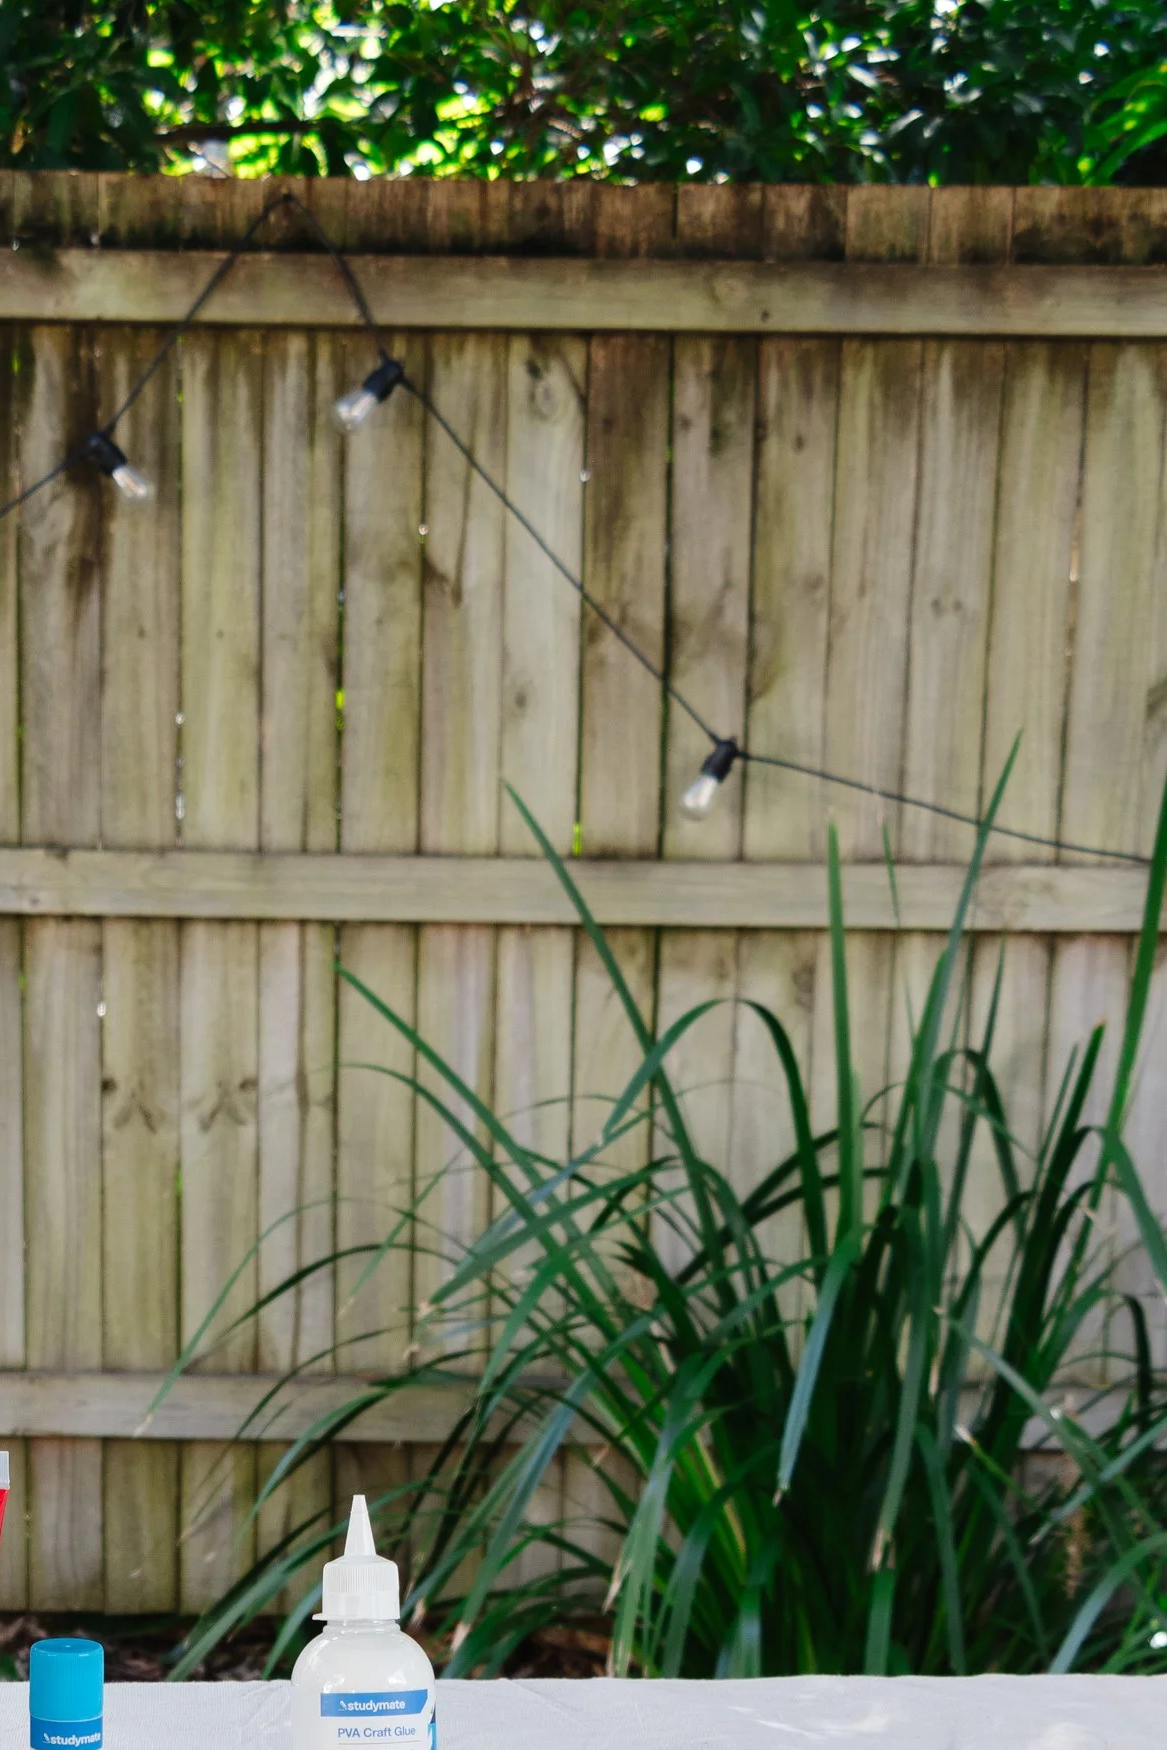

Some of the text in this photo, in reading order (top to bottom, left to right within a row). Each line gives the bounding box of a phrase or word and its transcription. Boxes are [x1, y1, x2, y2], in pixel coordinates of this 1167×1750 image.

[347, 1700, 406, 1712] studymate
[337, 1726, 416, 1738] PVA Craft Glue
[50, 1733, 101, 1747] studymate
